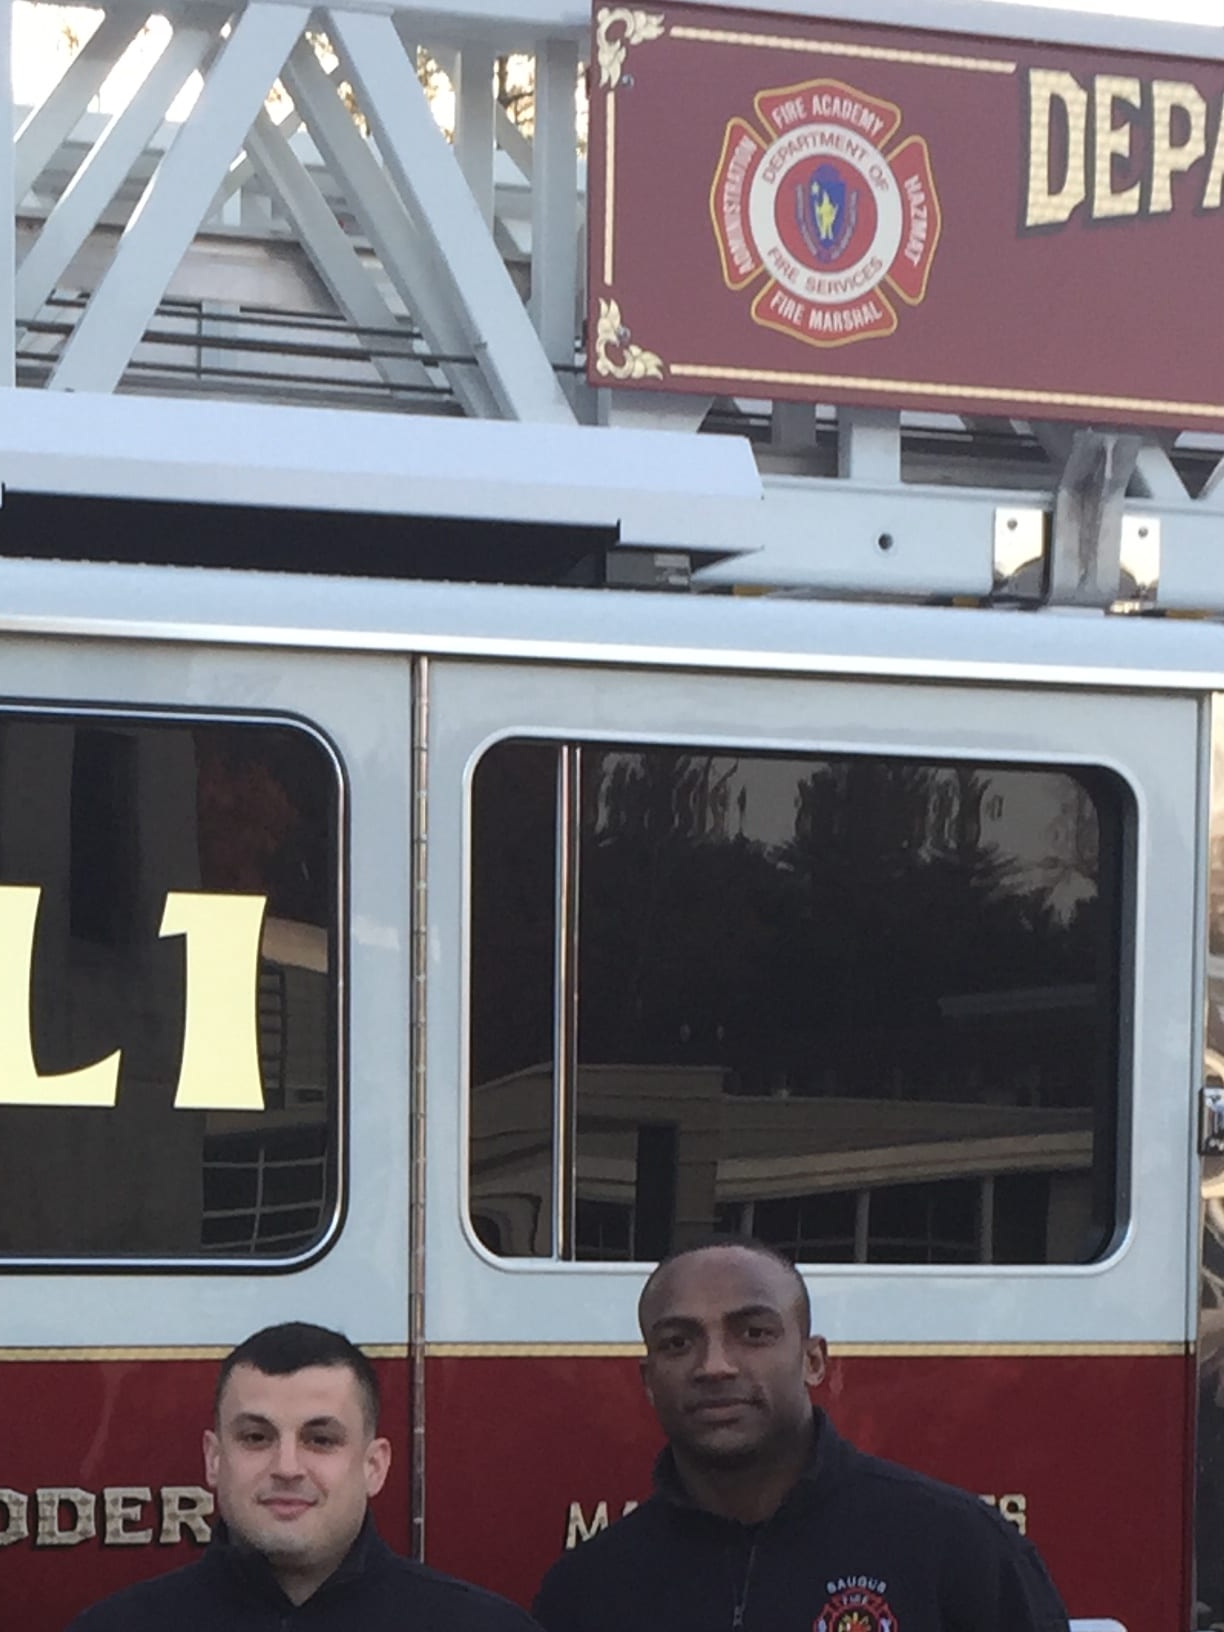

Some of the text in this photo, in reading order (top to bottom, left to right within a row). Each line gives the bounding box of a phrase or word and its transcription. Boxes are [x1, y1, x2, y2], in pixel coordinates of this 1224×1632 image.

[771, 94, 885, 137] FIRE ACADEMY
[762, 131, 890, 192] DEPARTMENT OF
[768, 247, 884, 295] FIRE SERVICES
[769, 290, 883, 332] FIRE MARSHAL
